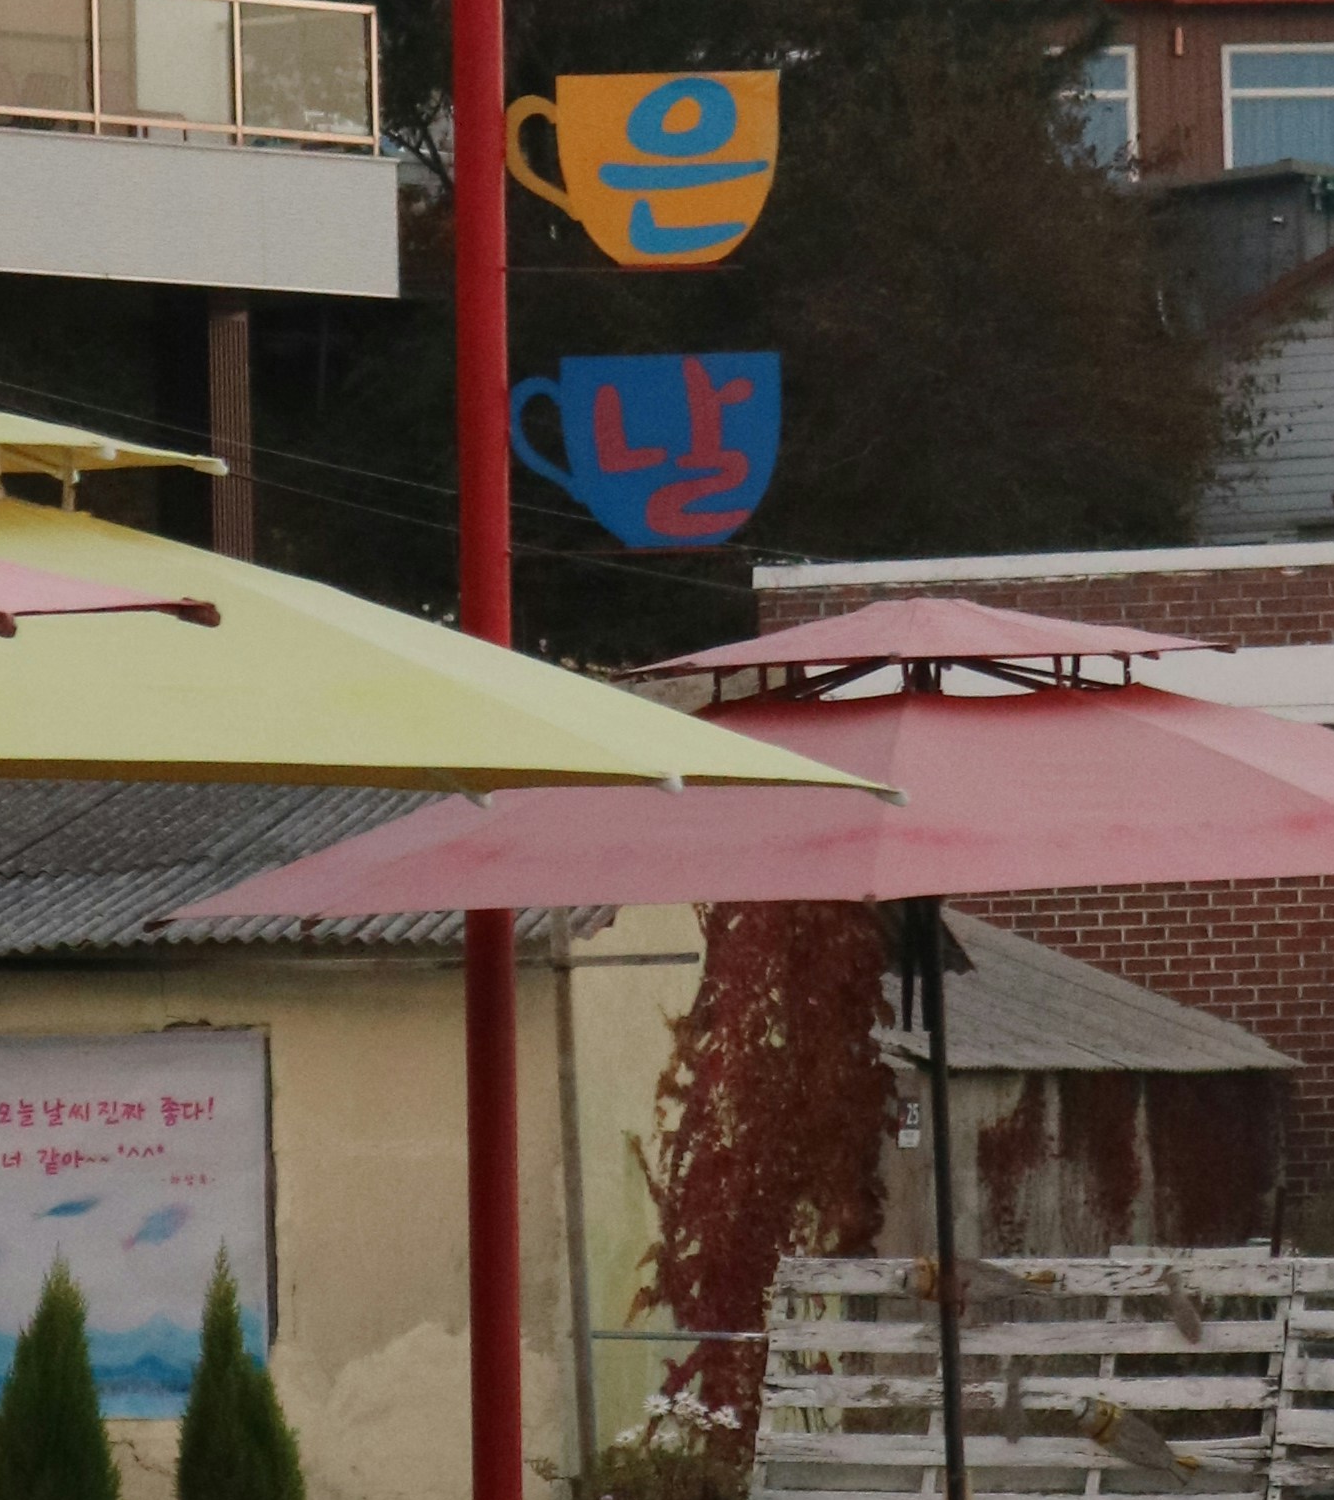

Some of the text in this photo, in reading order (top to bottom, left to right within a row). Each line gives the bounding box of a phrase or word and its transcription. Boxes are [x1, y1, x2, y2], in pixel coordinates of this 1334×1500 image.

[598, 76, 770, 255] 은
[593, 356, 755, 536] 날
[2, 1150, 21, 1168] 너
[43, 1098, 91, 1127] 날씨
[97, 1100, 146, 1125] 진짜
[160, 1097, 214, 1127] 좋다!
